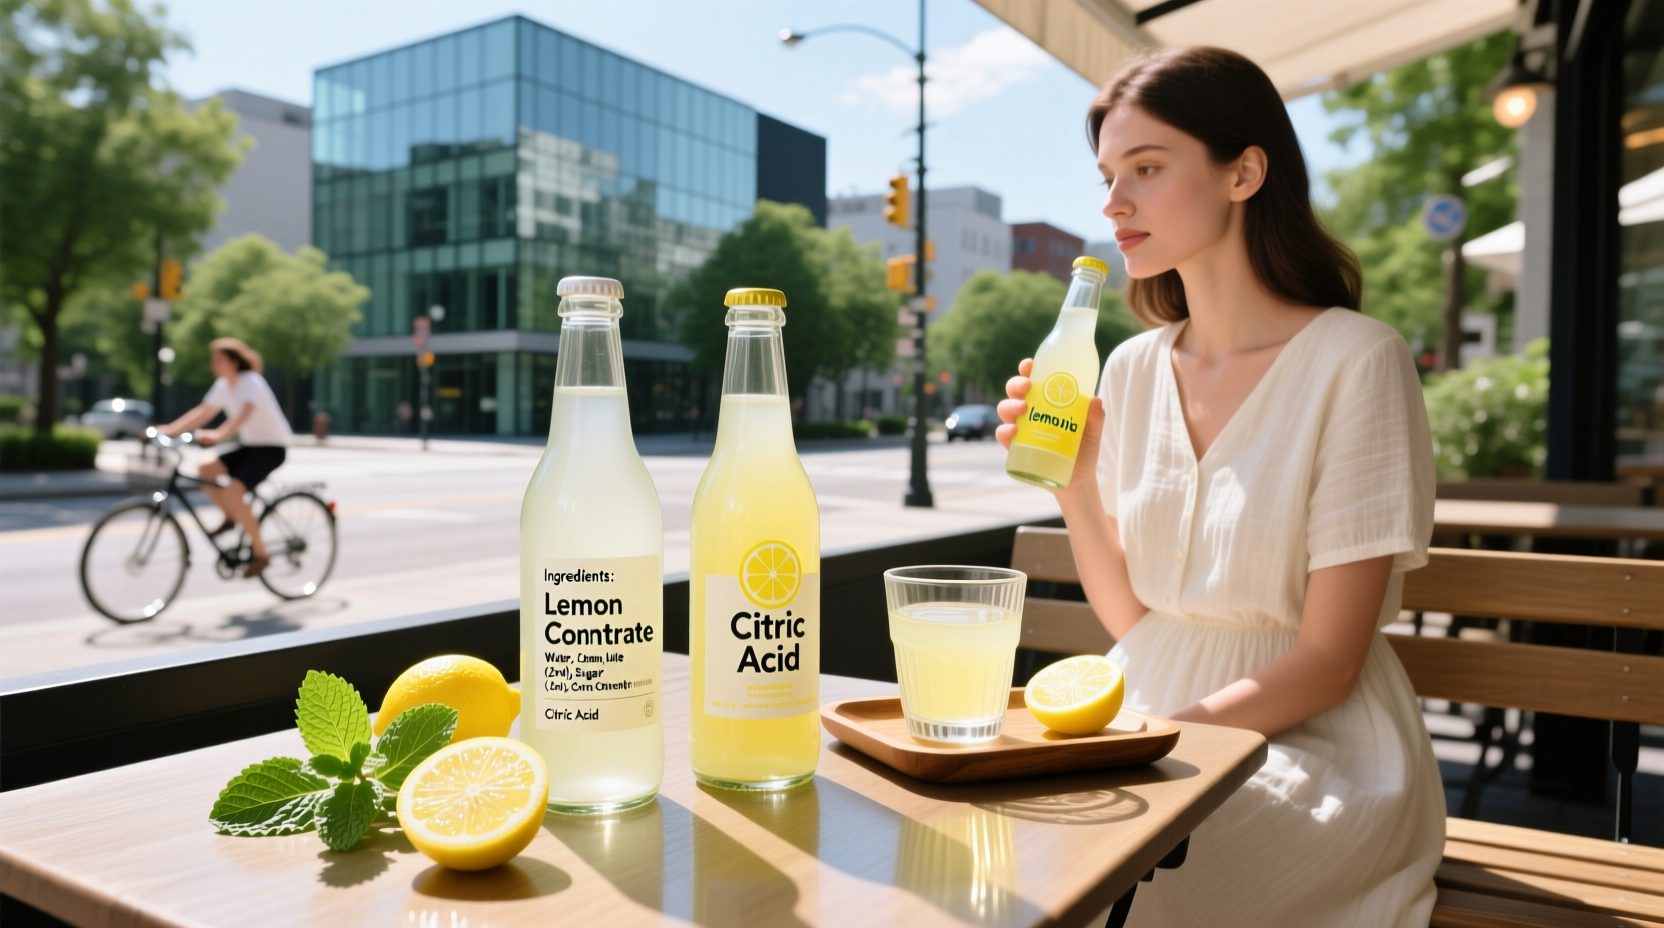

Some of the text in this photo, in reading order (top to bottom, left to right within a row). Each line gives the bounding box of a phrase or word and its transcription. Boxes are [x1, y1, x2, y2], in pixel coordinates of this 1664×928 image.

[544, 568, 614, 586] Ingredients:
[545, 592, 622, 616] Lemon
[545, 621, 653, 645] Conntrate
[731, 610, 805, 640] Citric
[736, 642, 800, 673] Acid
[575, 708, 599, 720] Acid
